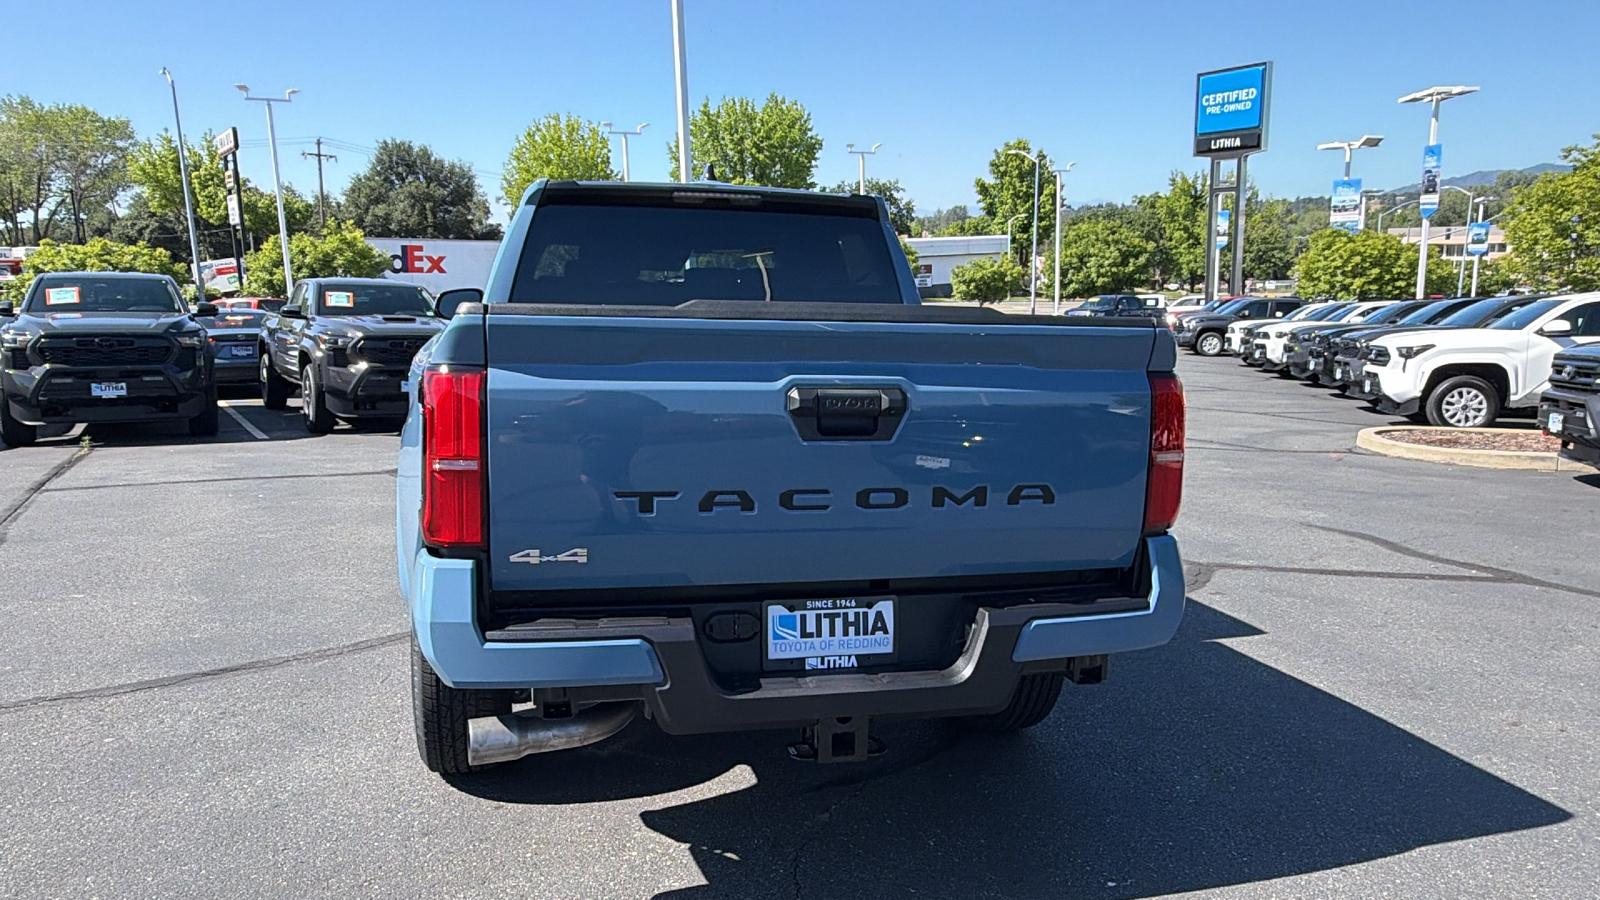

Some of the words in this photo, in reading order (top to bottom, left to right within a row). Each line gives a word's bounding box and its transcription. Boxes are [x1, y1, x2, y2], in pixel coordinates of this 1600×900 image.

[1202, 87, 1257, 106] CERTIFIED
[1206, 101, 1252, 115] PRE-OWNED
[1211, 137, 1241, 149] LITHIA
[389, 244, 447, 274] dEx
[826, 398, 878, 409] TOYOTA
[613, 484, 1056, 515] TACOMA
[509, 548, 588, 564] 4x4
[806, 600, 833, 609] SINCE
[836, 599, 857, 608] 1946
[800, 610, 889, 639] LITHIA
[773, 641, 816, 653] TOYOTA
[820, 640, 835, 650] OF
[838, 637, 890, 649] REDDING
[817, 655, 858, 669] LITHIA
